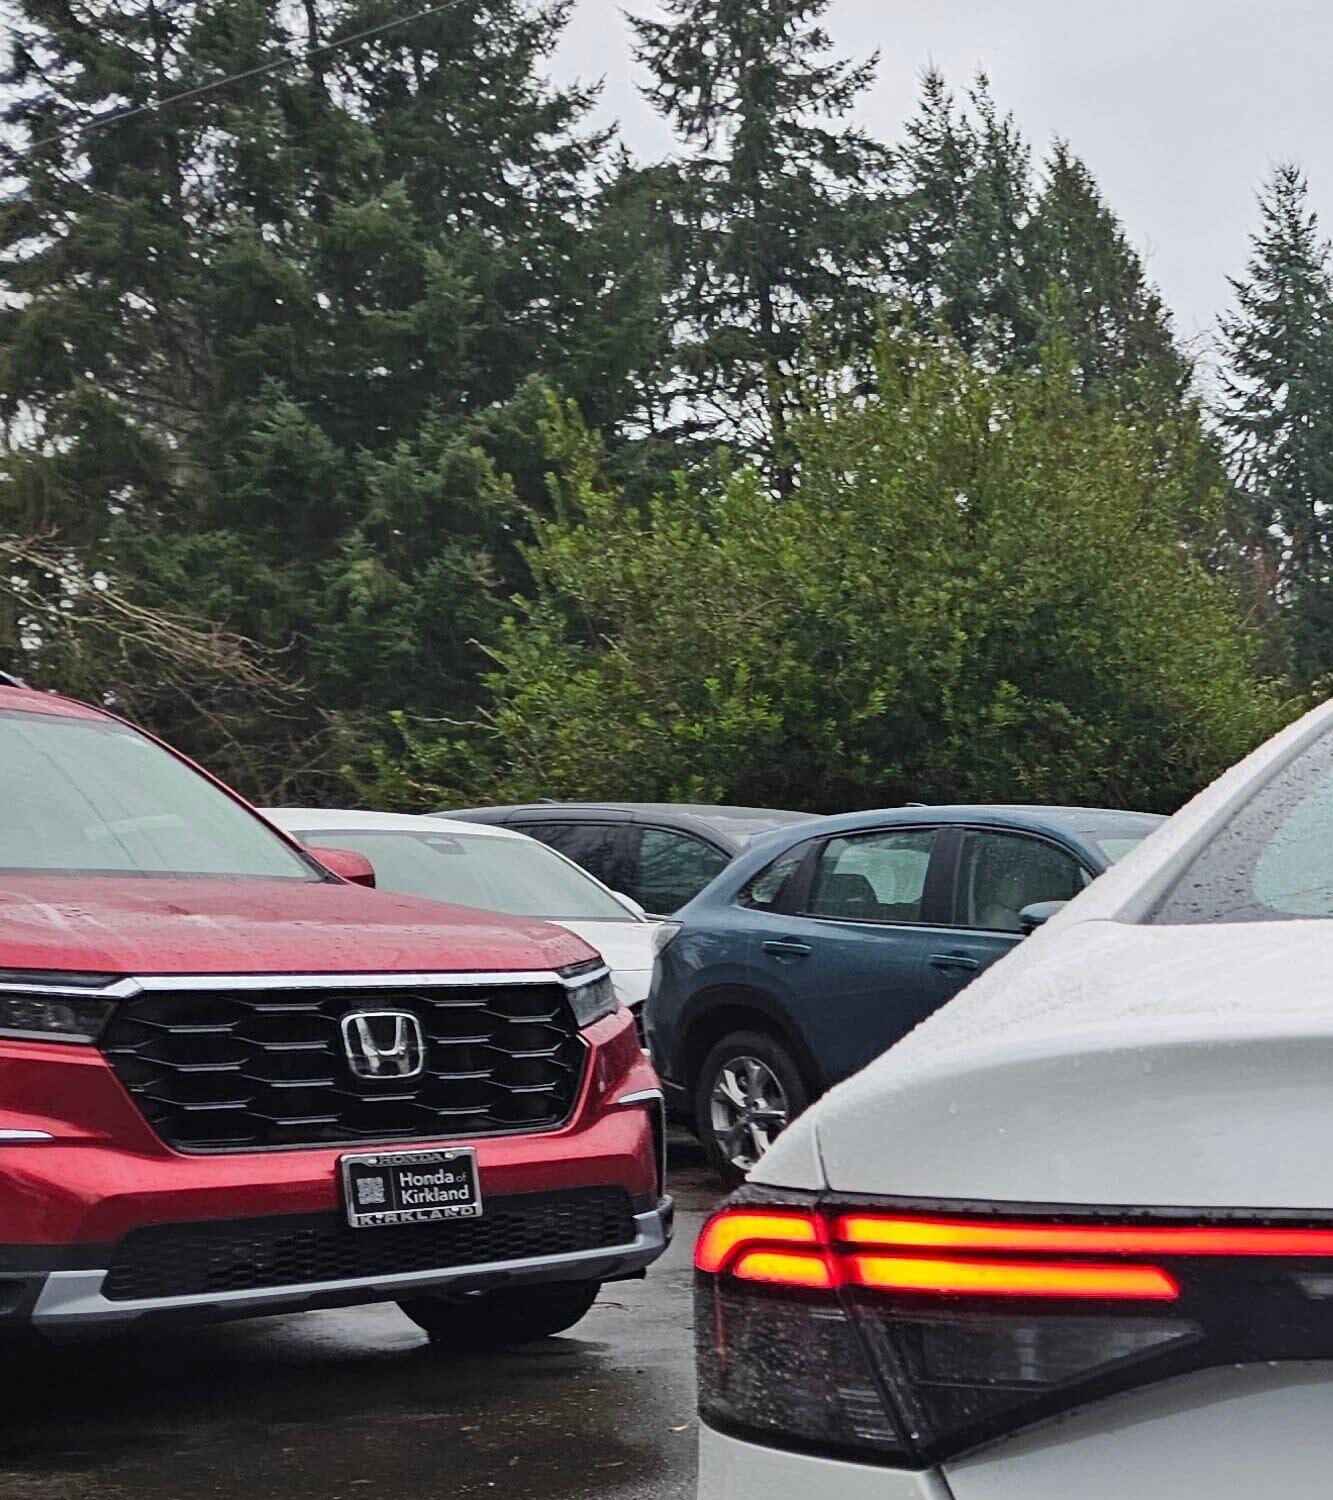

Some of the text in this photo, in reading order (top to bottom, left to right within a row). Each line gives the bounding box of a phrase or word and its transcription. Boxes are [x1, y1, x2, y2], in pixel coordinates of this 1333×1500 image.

[400, 1169, 466, 1186] Honda of
[401, 1185, 469, 1204] Kirkland
